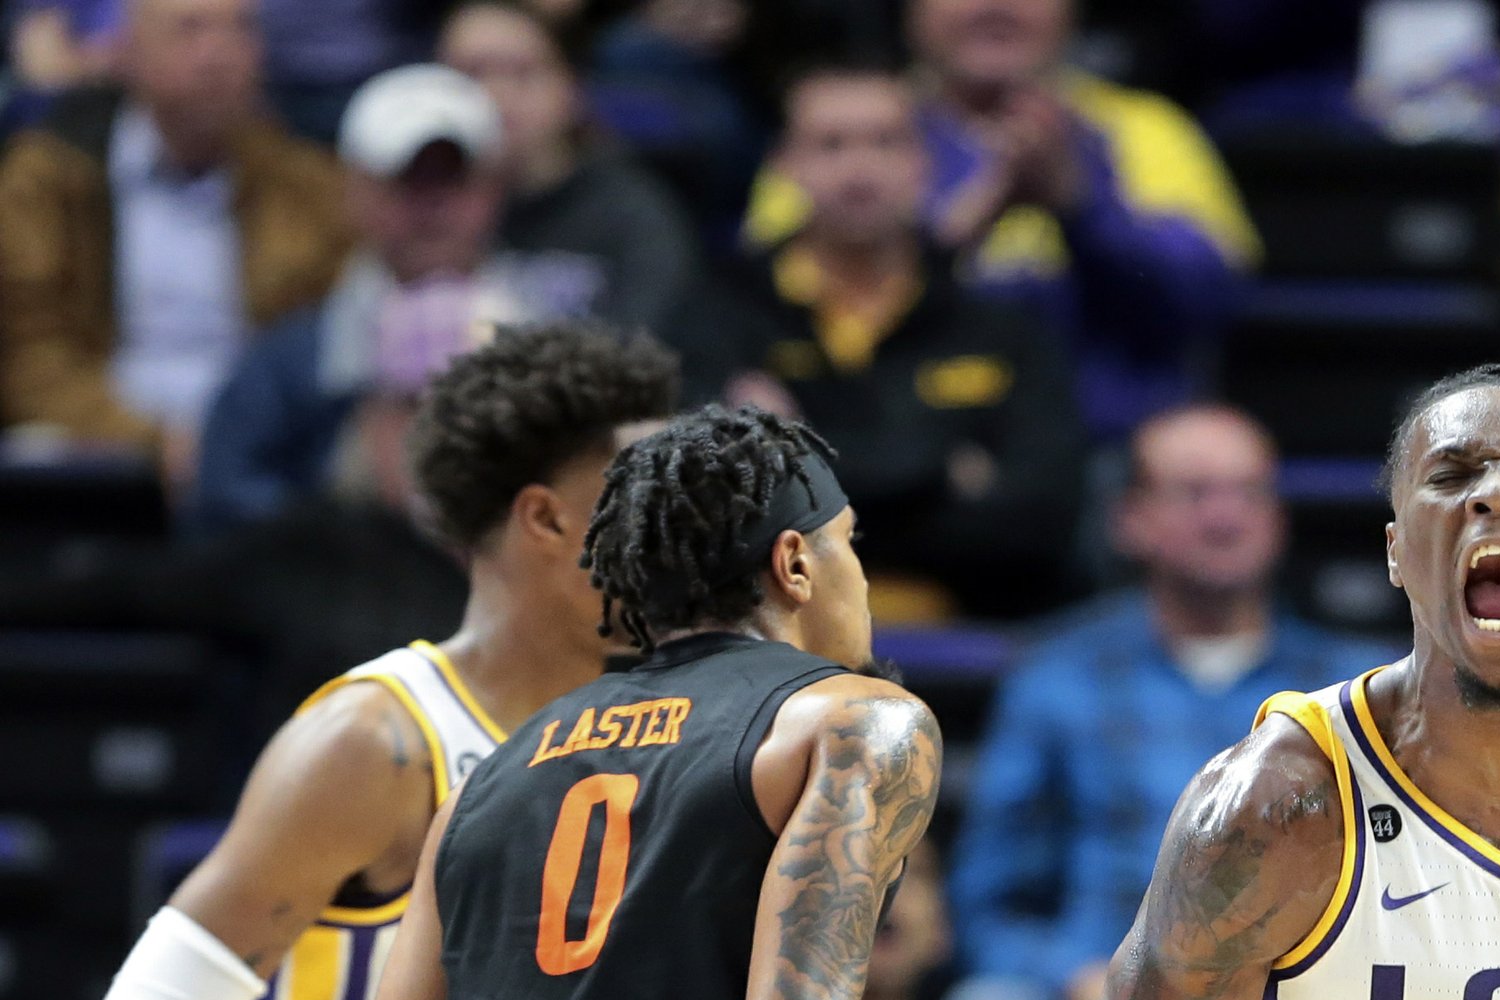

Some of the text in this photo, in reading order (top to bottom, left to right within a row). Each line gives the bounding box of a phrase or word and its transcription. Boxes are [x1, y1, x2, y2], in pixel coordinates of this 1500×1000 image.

[528, 697, 692, 768] LASTER
[1373, 819, 1394, 837] 44
[535, 772, 639, 976] 0
